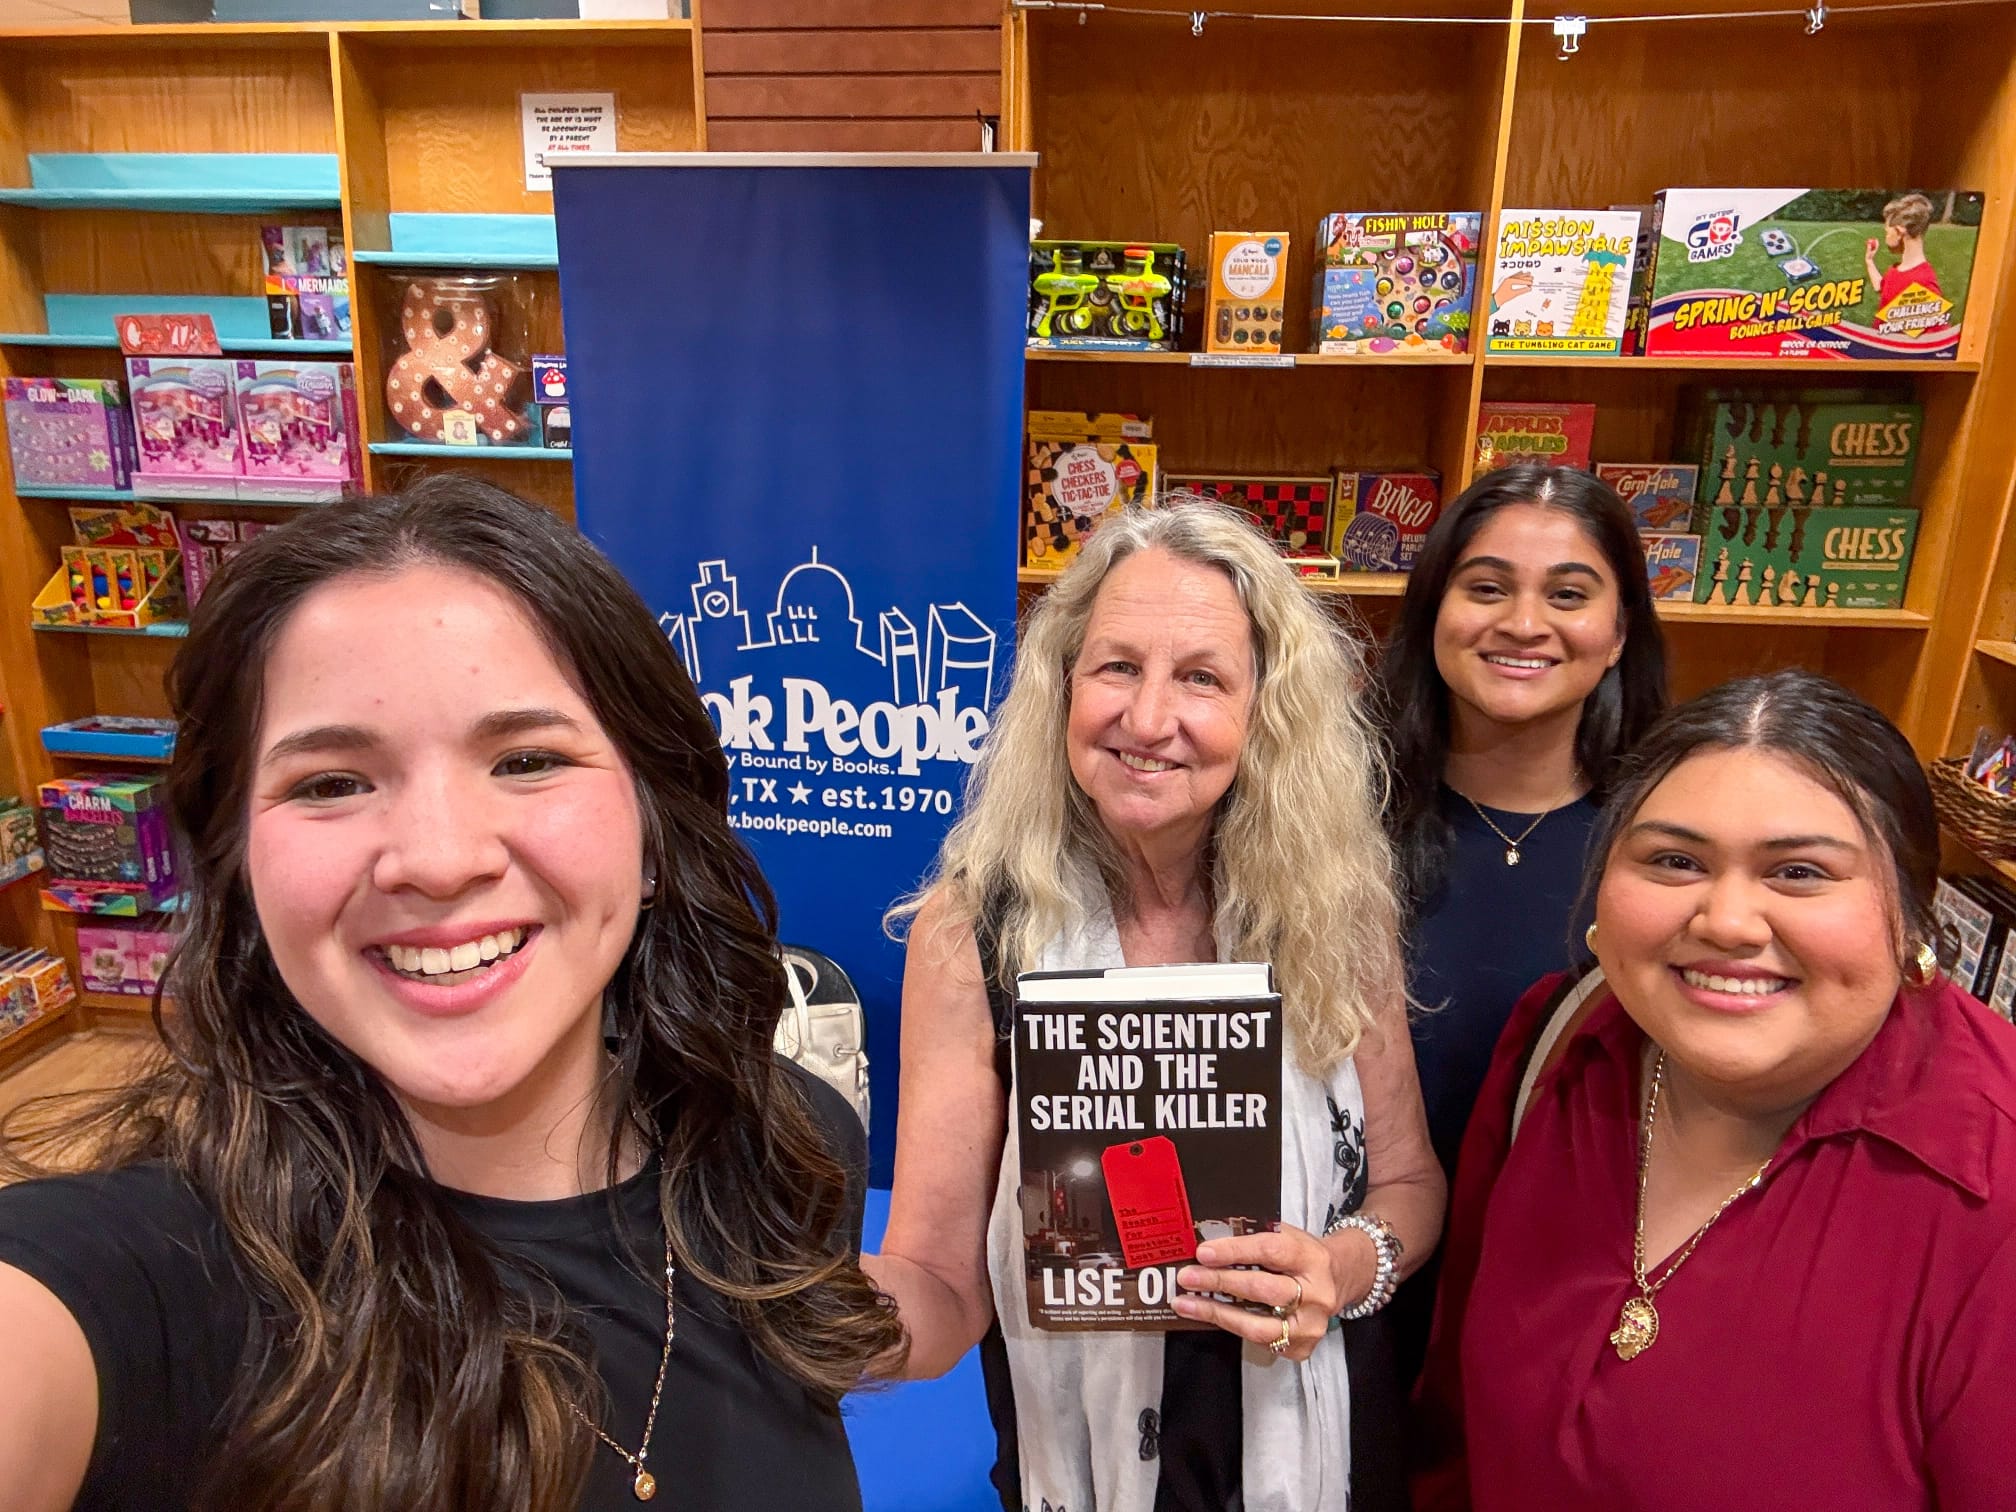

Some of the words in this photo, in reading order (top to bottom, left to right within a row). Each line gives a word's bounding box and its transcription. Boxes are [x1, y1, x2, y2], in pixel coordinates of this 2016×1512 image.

[1365, 216, 1409, 233] FISHIN'
[1412, 214, 1446, 230] HOLE
[1503, 218, 1594, 239] MISSION
[1499, 235, 1633, 258] IMPAWSIBLE
[1690, 242, 1733, 260] GAMES
[1229, 264, 1270, 275] MANCALA
[1500, 260, 1541, 270] ネコひねり
[298, 278, 349, 293] MERMAIDS
[1674, 293, 1756, 330] SPRING
[1760, 287, 1787, 319] N'
[1789, 278, 1865, 314] SCORE
[1887, 301, 1941, 319] CHALLENGE
[1729, 321, 1774, 340] BOUNCE
[1777, 318, 1804, 334] BALL
[1805, 312, 1841, 328] GAME
[1879, 321, 1905, 334] YOUR
[1906, 313, 1951, 329] FRIENDS!
[1497, 341, 1515, 349] THE
[1518, 341, 1565, 349] TUMBLING
[1567, 341, 1585, 349] CAT
[27, 387, 56, 403] GLOW
[67, 388, 96, 403] DARK
[1487, 415, 1562, 433] APPLES
[1495, 435, 1567, 454] APPLES
[1831, 423, 1912, 456] CHESS
[1067, 459, 1096, 475] CHESS
[1061, 471, 1107, 489] CHECKERS
[1061, 484, 1111, 503] TIC-TAC-TOE
[1372, 478, 1433, 527] BINGO
[1824, 527, 1907, 560] CHESS
[1400, 552, 1412, 561] SET
[782, 677, 990, 776] People
[741, 752, 800, 770] Bound
[805, 755, 827, 775] by
[832, 758, 895, 776] Books.
[68, 793, 111, 811] CHARM
[1022, 1013, 1086, 1050] THE
[1097, 1011, 1271, 1050] SCIENTIST
[1077, 1054, 1144, 1090] AND
[1154, 1053, 1218, 1090] THE
[1030, 1094, 1145, 1131] SERIAL
[1155, 1093, 1267, 1129] KILLER
[1119, 1208, 1137, 1217] The
[1125, 1232, 1143, 1240] for
[1042, 1267, 1124, 1306] LISE
